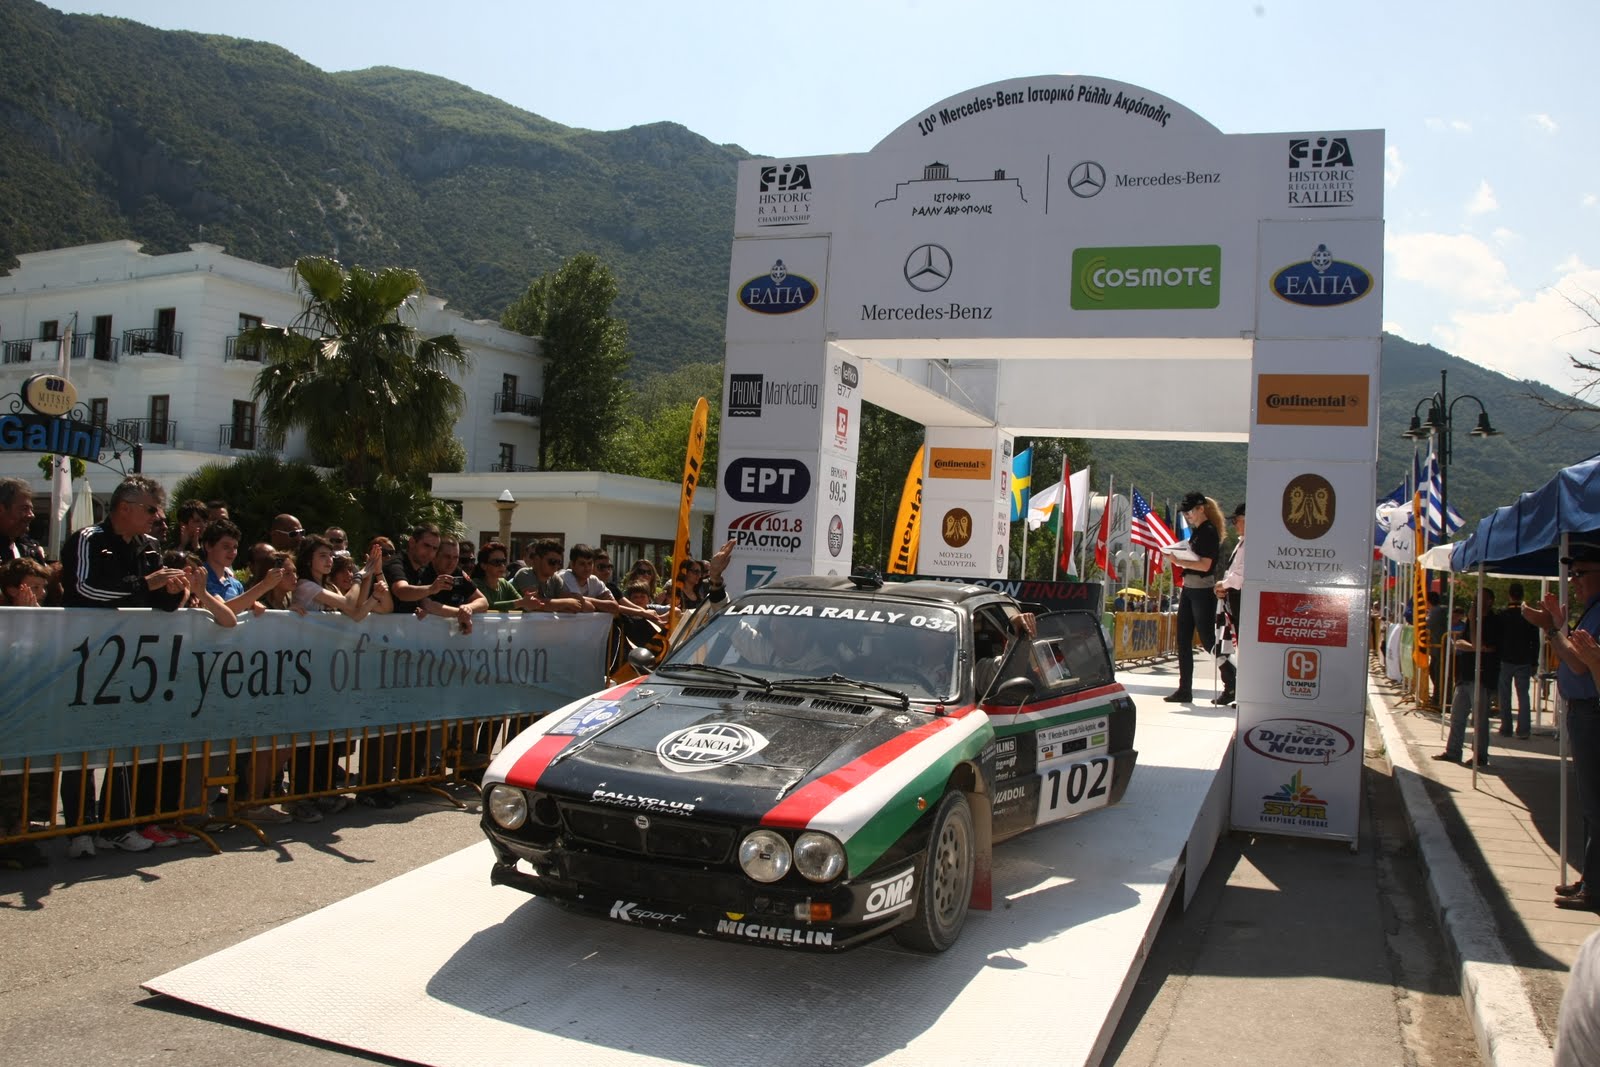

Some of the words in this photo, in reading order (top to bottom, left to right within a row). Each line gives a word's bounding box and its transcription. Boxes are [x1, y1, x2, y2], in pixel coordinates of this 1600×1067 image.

[939, 91, 1024, 126] Mercedes-Benz
[1027, 84, 1075, 104] Ιστορικό
[1077, 85, 1112, 106] Ράλλυ
[1112, 91, 1171, 128] Ακρόπολις
[1114, 171, 1221, 188] Mercedes-Benz
[1289, 170, 1355, 182] HISTORIC
[1288, 182, 1354, 191] REGULARITY
[759, 192, 812, 204] HISTORIC
[1288, 190, 1354, 203] RALLIES
[758, 204, 811, 215] RALLY
[757, 214, 811, 223] CHAMPIONSHIP
[1093, 267, 1213, 289] COSMOTE
[1284, 275, 1359, 296] ΕΛΠΑ
[747, 286, 806, 305] ΕΛΠΑ
[860, 303, 993, 321] Mercedes-Benz
[38, 391, 70, 405] MITSIS
[732, 381, 762, 405] PHONE
[765, 380, 819, 410] Marketing
[1265, 393, 1346, 409] Continental
[0, 416, 102, 460] Galini
[934, 459, 980, 469] Continental
[765, 517, 803, 533] 101.8
[1276, 546, 1336, 559] ΜΟΥΣΕΙΟ
[933, 558, 977, 568] ΝΑΣΙΟΥΤΖΙΚ
[1267, 559, 1344, 573] ΝΑΣΙΟΥΤΖΙΚ
[724, 604, 814, 617] LANCIA
[820, 607, 905, 624] RALLY
[910, 615, 957, 633] 037
[1266, 616, 1340, 630] SUPERFAST
[1274, 627, 1327, 639] FERRIES
[68, 635, 183, 707] 125!
[191, 648, 312, 718] years
[329, 633, 371, 692] of
[379, 635, 549, 690] innovation
[1286, 680, 1317, 688] OLYMPUS
[685, 737, 731, 752] LANCIA
[1258, 729, 1336, 747] Drivers
[1268, 741, 1325, 757] News
[1047, 757, 1109, 810] 102
[592, 789, 696, 811] RALLYCLUB
[1263, 801, 1328, 819] STAR
[866, 874, 914, 913] OMP
[716, 919, 833, 946] MICHELIN
